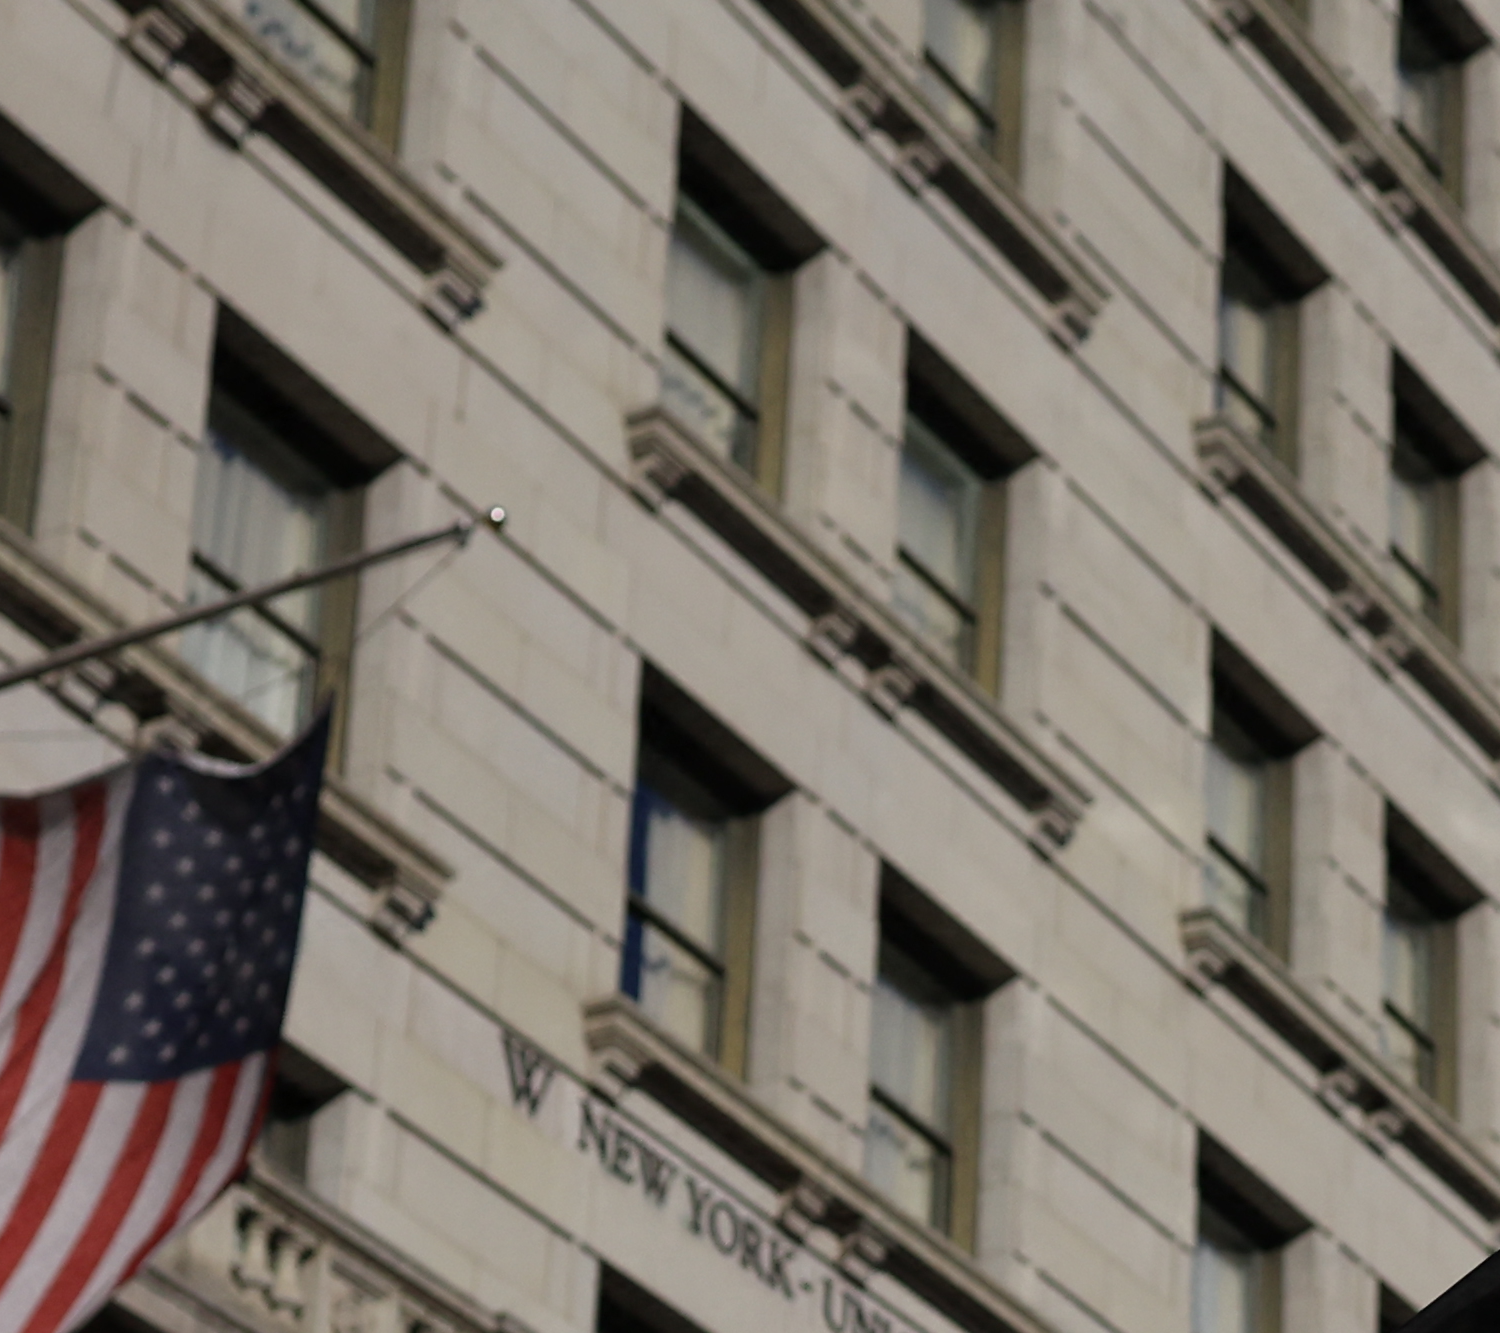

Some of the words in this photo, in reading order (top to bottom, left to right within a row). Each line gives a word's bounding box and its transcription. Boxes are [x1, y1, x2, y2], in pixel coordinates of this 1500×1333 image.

[502, 1028, 554, 1118] W
[577, 1098, 678, 1206] NEW
[685, 1174, 796, 1300] YORK
